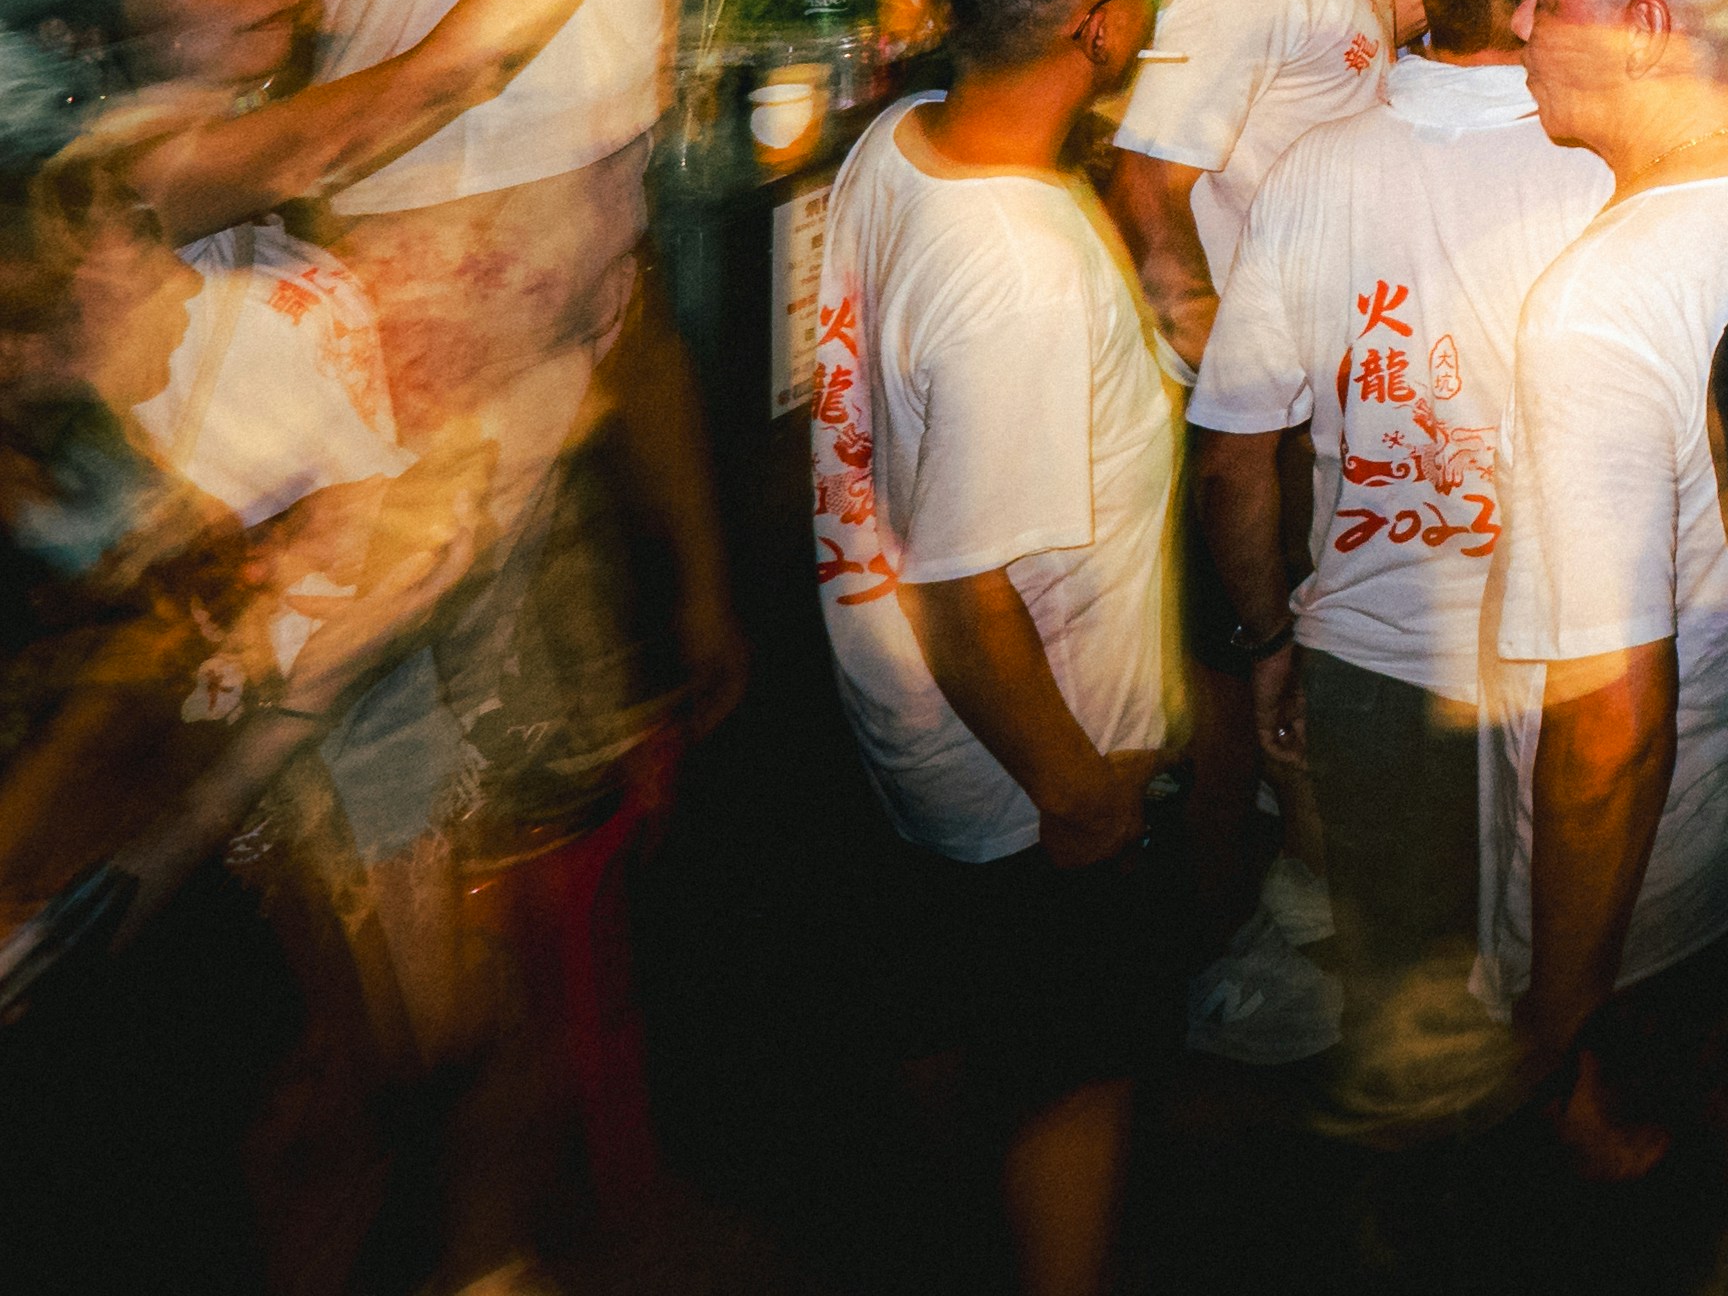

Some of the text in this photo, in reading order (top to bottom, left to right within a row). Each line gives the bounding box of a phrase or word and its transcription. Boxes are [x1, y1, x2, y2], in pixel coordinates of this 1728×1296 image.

[810, 297, 858, 423] 火龍
[1354, 279, 1416, 404] 火龍
[1433, 351, 1455, 394] 大坑
[1334, 493, 1501, 558] 2023
